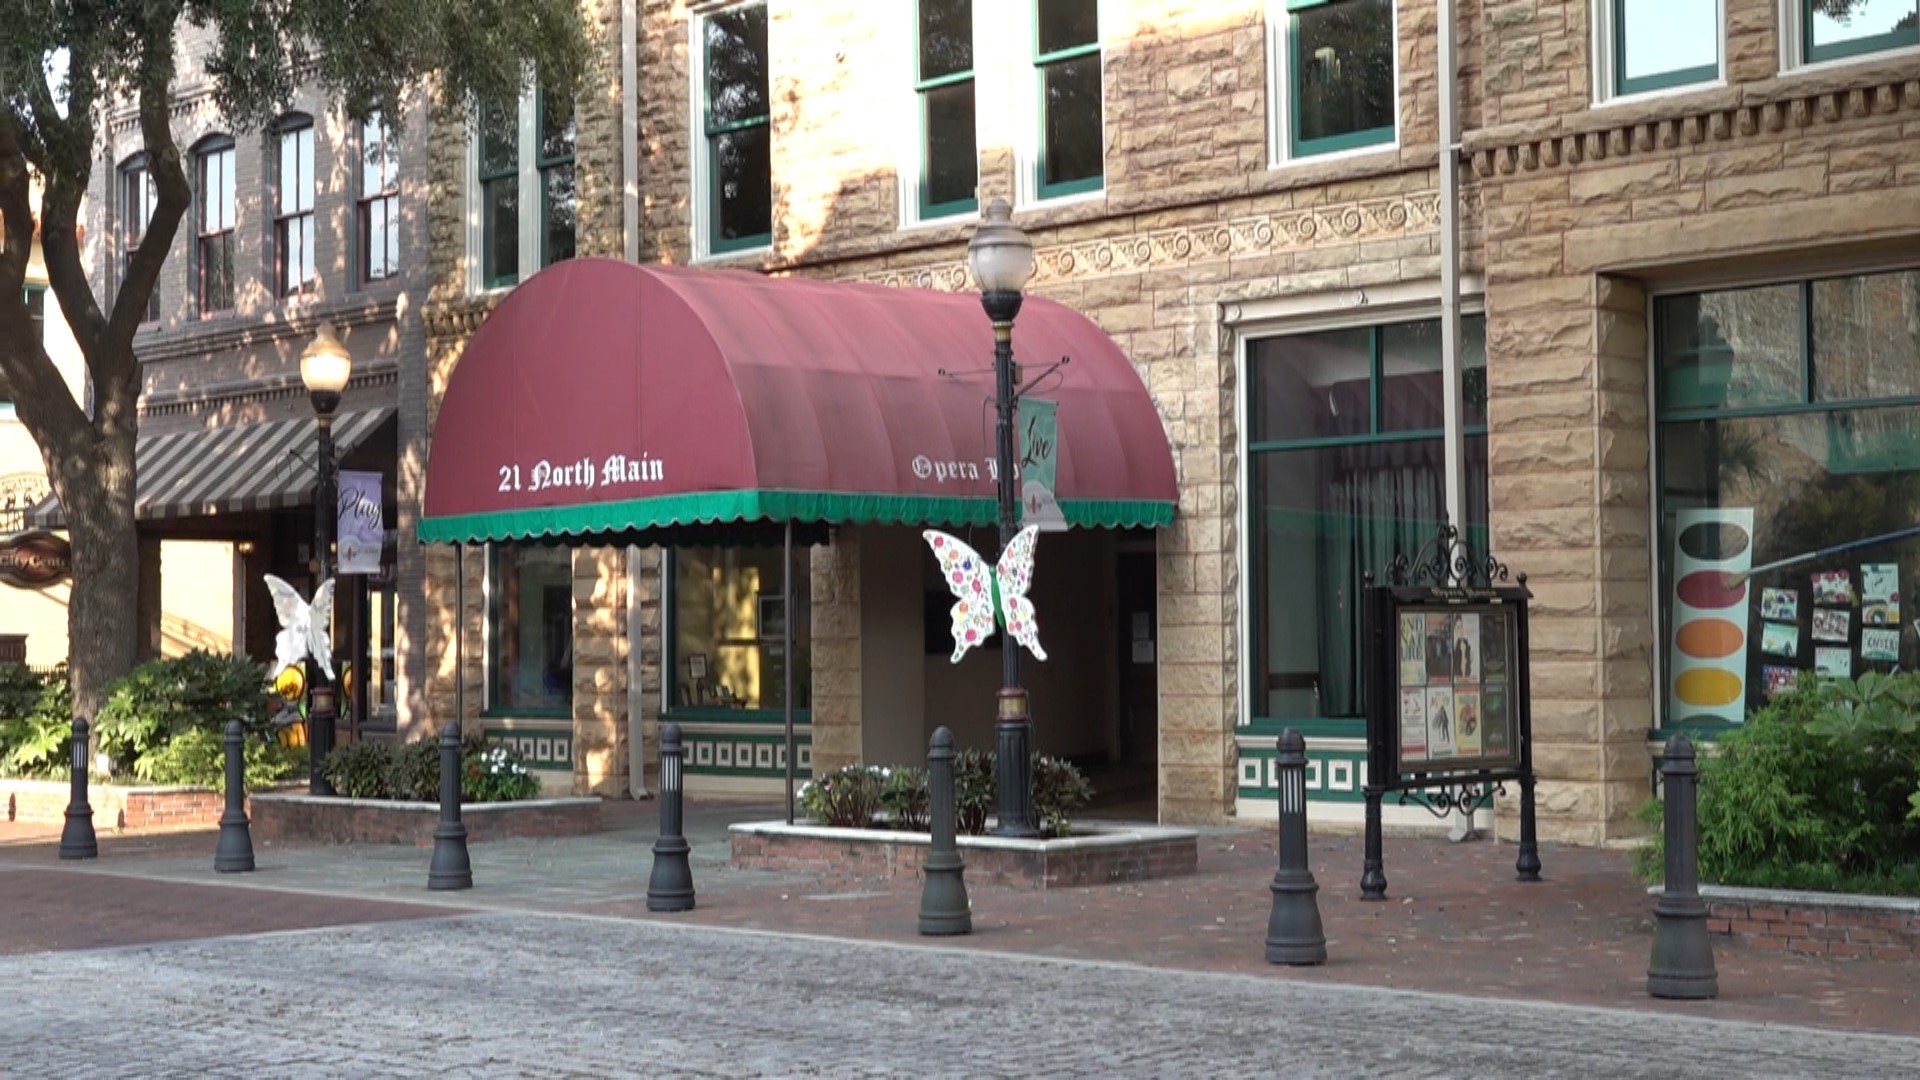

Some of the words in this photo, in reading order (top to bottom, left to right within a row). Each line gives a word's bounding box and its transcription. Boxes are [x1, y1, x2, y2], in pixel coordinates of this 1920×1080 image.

[1021, 415, 1052, 468] Live
[498, 465, 521, 492] 21
[528, 457, 595, 492] North
[601, 451, 664, 487] Main
[911, 454, 979, 484] Opera
[338, 487, 381, 531] Play
